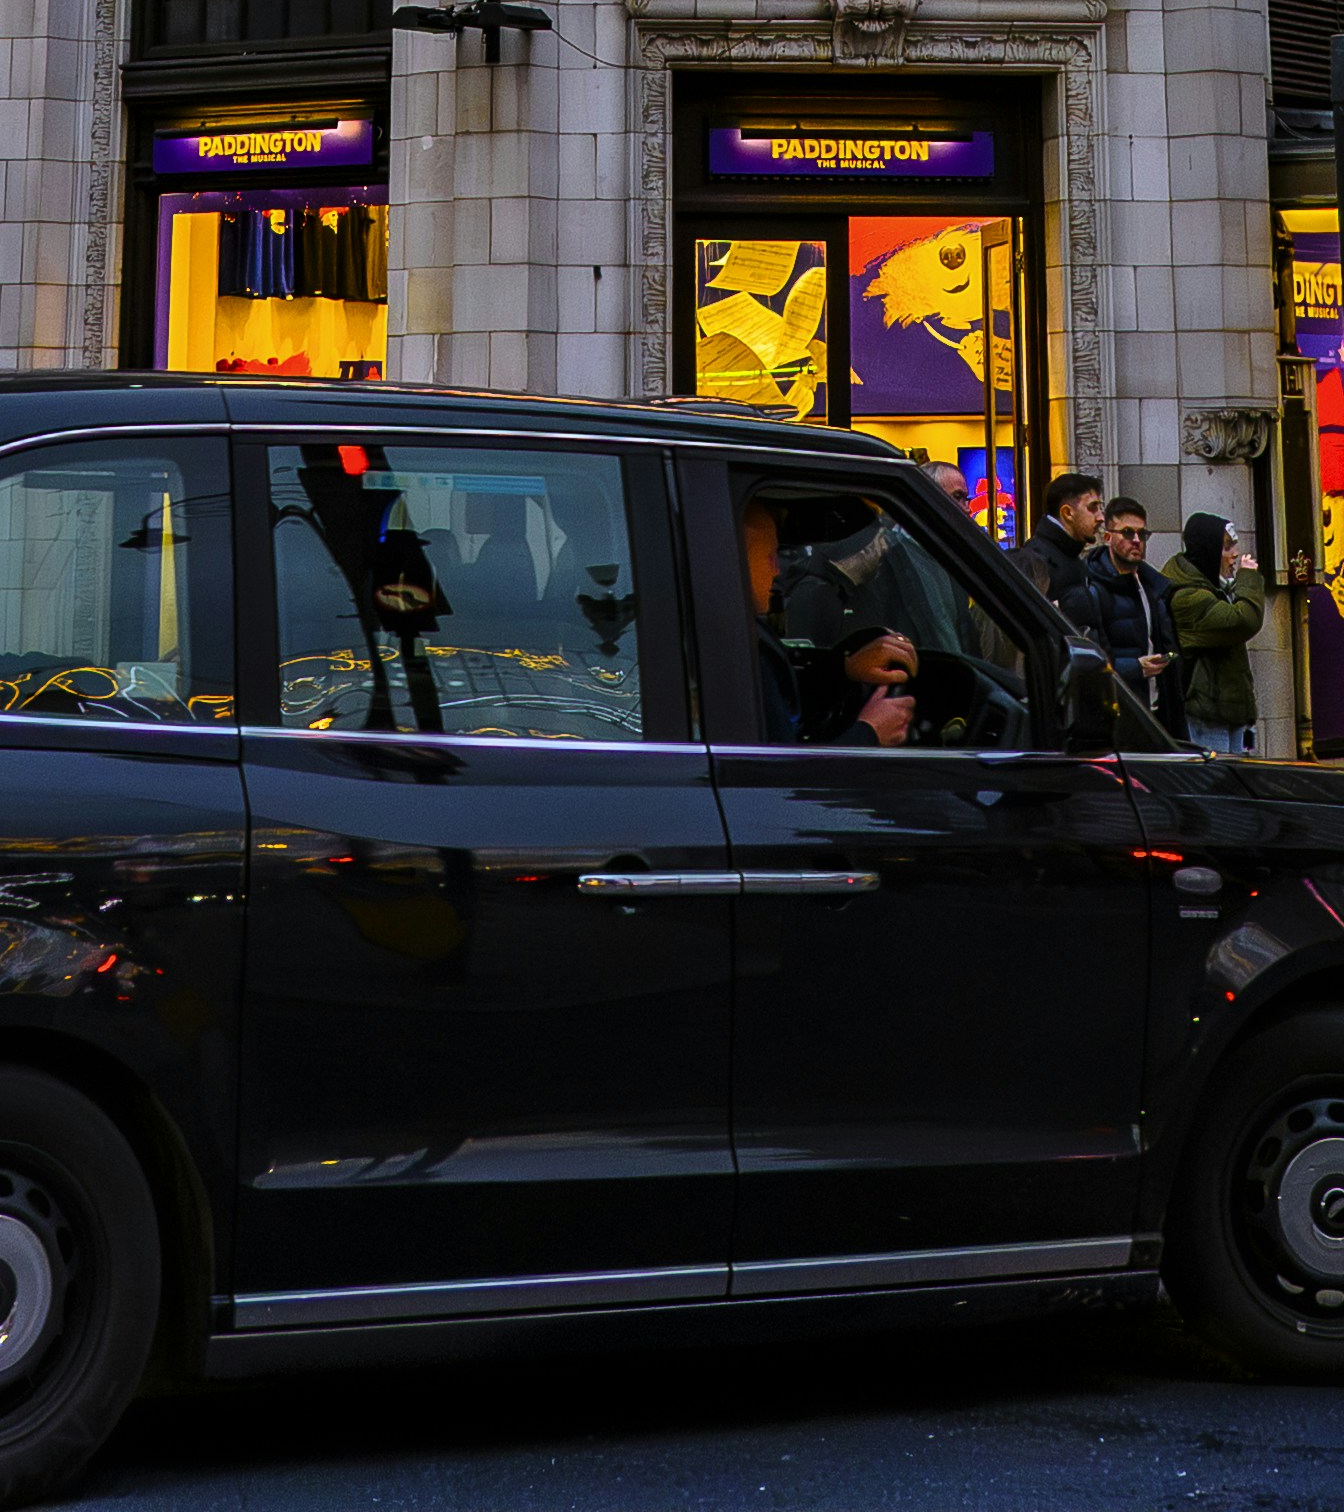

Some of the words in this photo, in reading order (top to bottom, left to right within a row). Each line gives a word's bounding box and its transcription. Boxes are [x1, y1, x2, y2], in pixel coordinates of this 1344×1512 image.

[198, 131, 323, 157] PADDINGTON
[771, 139, 929, 162] PADDINGTON
[233, 155, 249, 164] THE
[250, 153, 287, 164] MUSICAL
[816, 159, 837, 168] THE
[840, 159, 886, 169] MUSICAL
